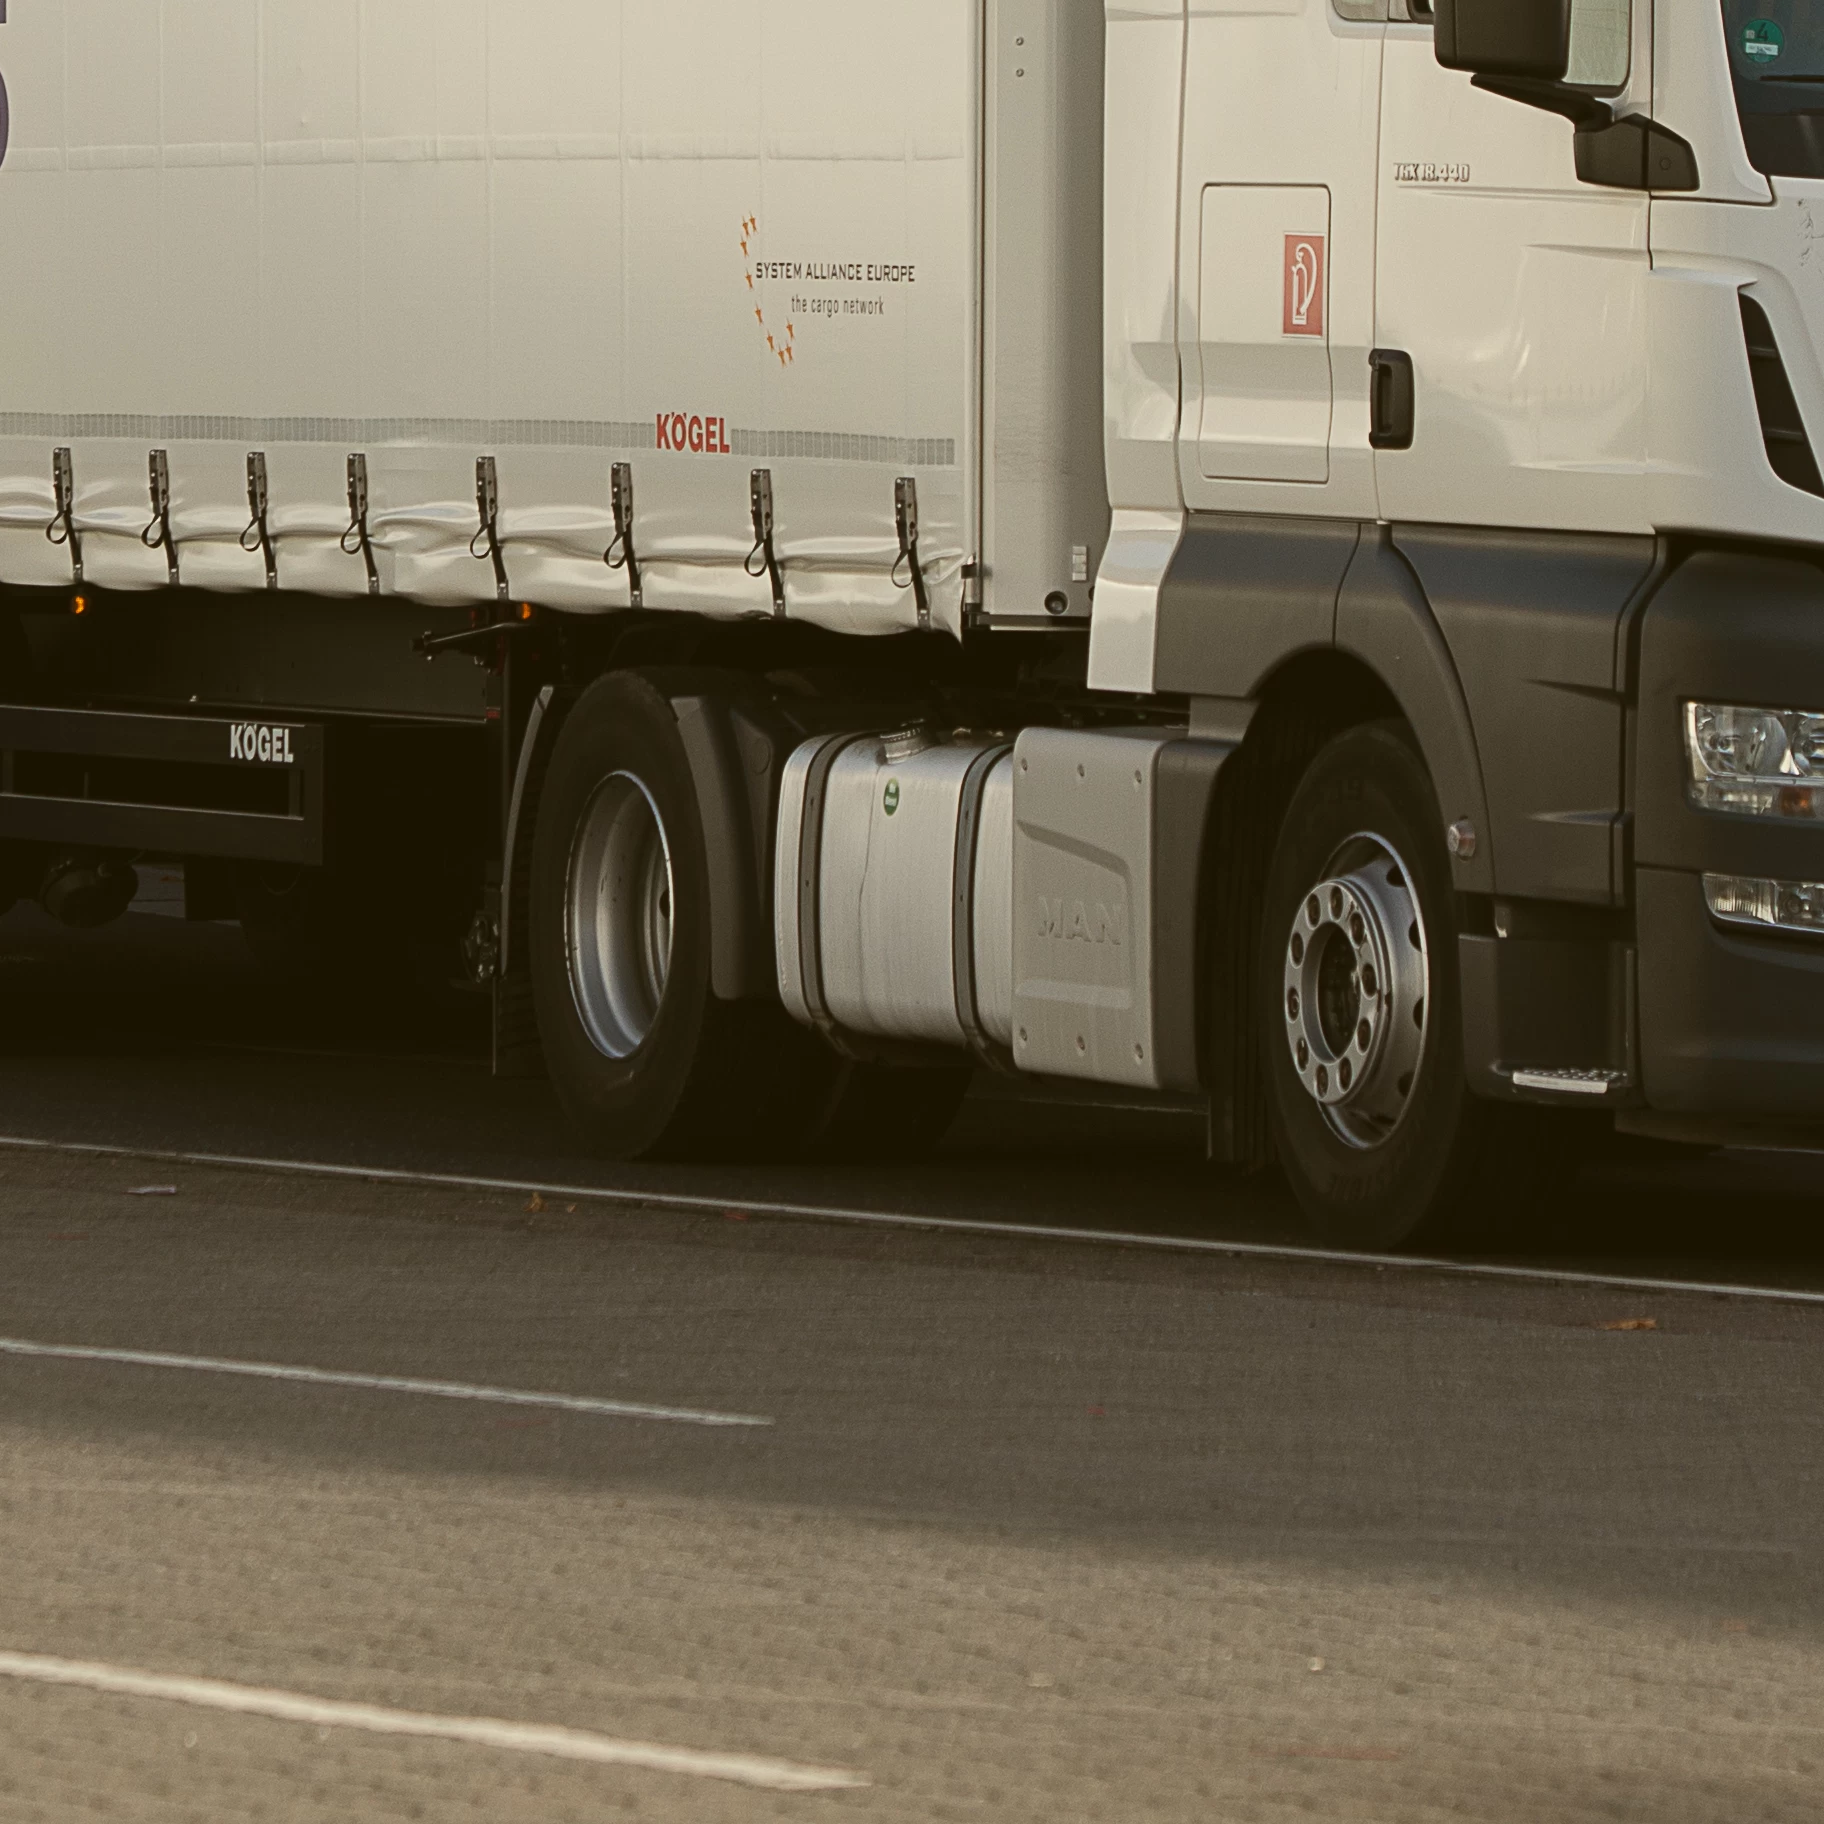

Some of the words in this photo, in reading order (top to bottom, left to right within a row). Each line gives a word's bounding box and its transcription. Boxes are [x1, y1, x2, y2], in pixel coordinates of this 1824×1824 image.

[1756, 22, 1769, 41] 4
[1421, 163, 1470, 183] 18.440
[755, 262, 802, 279] SYSTEM
[805, 263, 863, 281] ALLIANCE
[867, 264, 915, 282] EUROPE
[791, 294, 808, 313] the
[811, 298, 839, 318] cargo
[843, 296, 884, 315] network
[655, 411, 731, 454] KÖGEL
[230, 722, 294, 763] KÖGEL
[1037, 895, 1121, 946] MAN
